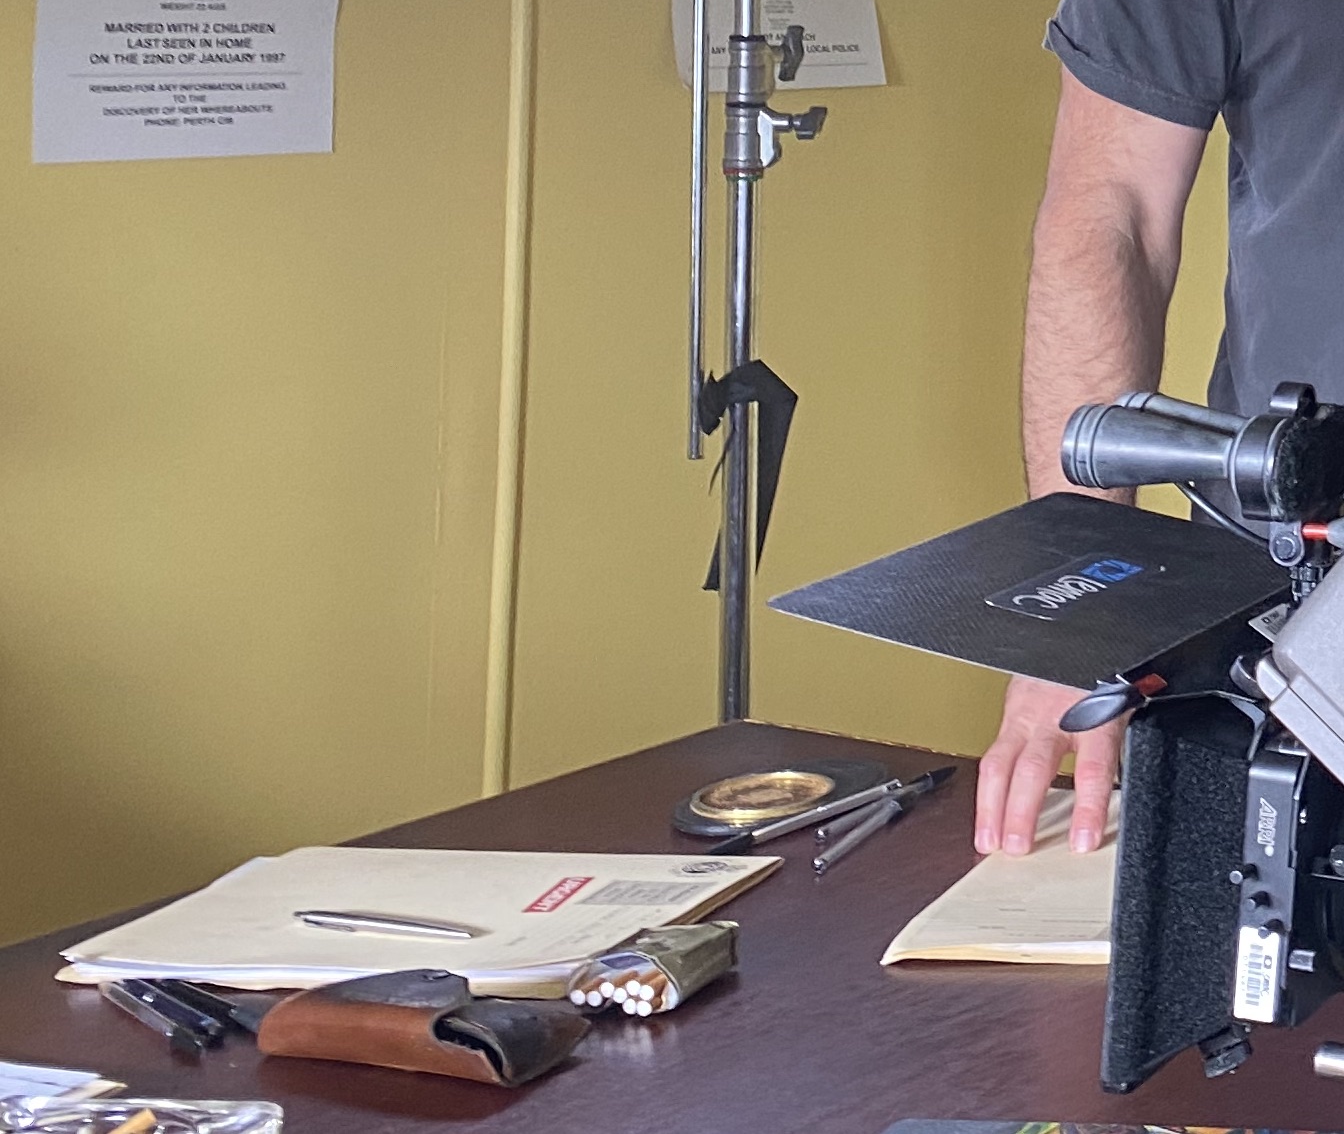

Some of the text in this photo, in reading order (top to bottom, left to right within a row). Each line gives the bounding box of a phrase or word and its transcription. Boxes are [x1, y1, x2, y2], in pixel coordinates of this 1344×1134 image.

[104, 22, 276, 34] MARRIED WITH 2 CHILDREN
[127, 37, 253, 49] LAST SEEN IN HOME
[88, 53, 109, 64] ON
[114, 53, 138, 64] THE
[178, 53, 196, 64] OF
[199, 53, 256, 64] JANUARY
[1257, 797, 1278, 846] ARRI
